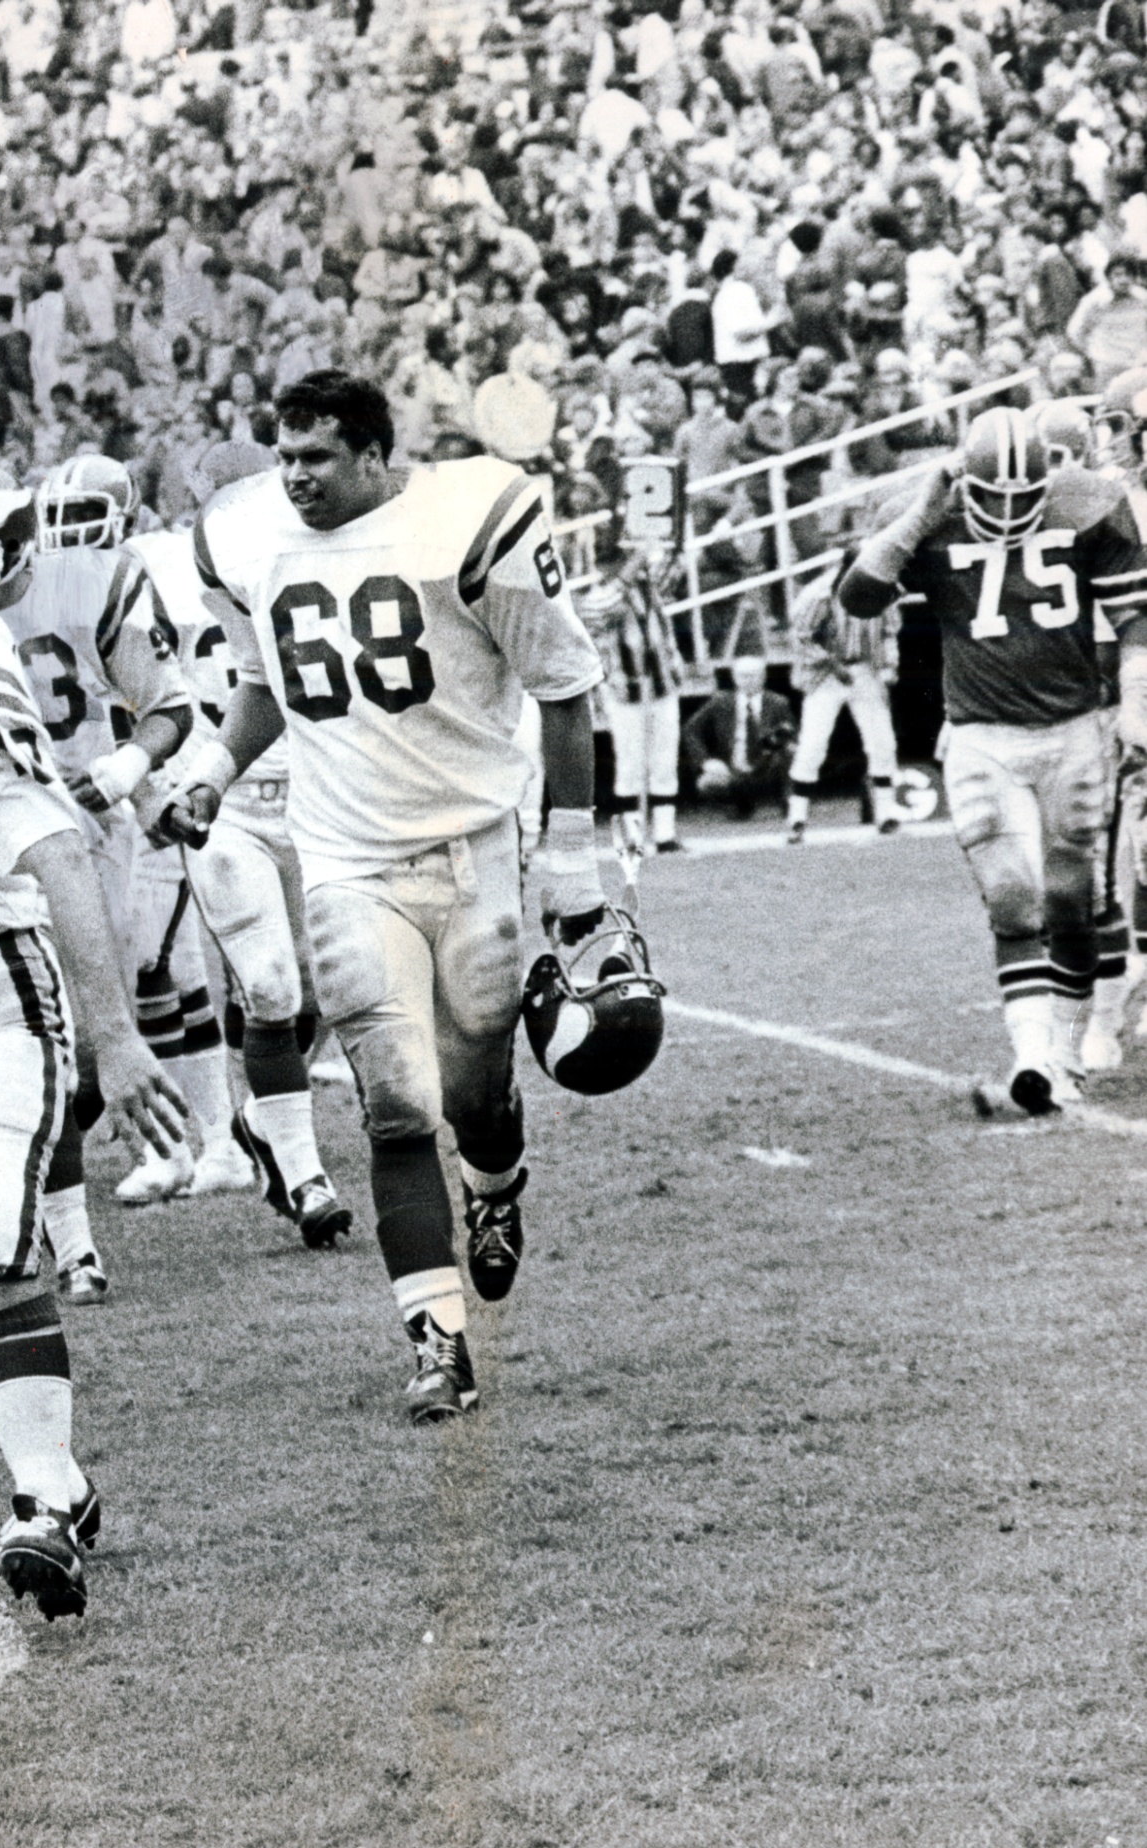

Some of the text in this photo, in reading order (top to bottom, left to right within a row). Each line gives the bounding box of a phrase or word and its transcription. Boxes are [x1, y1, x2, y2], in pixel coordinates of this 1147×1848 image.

[625, 466, 673, 538] 2
[947, 528, 1080, 639] 75
[270, 575, 436, 722] 68
[890, 767, 938, 821] G
